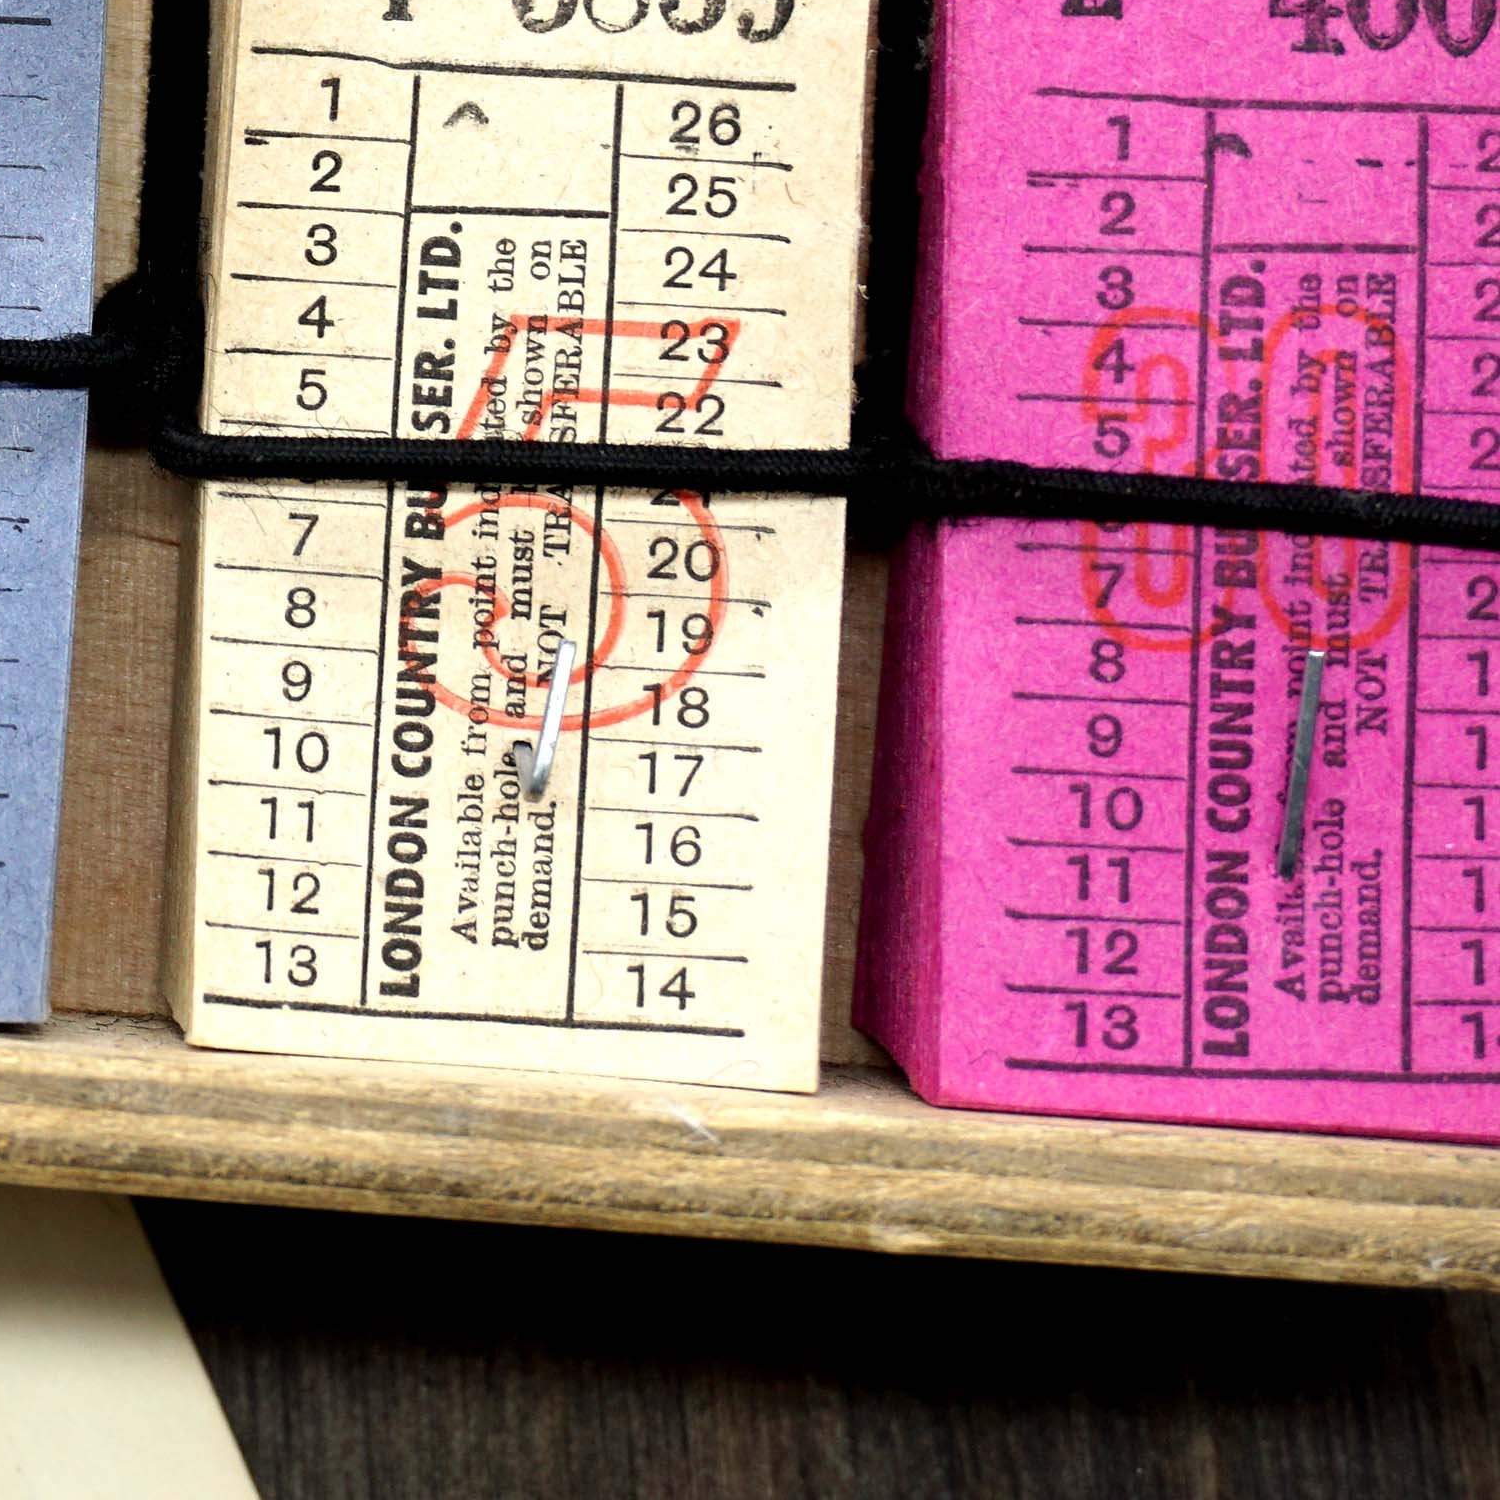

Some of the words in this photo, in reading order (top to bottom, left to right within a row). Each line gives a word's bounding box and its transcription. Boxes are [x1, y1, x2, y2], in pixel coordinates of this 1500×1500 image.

[321, 78, 340, 121] 1
[669, 100, 741, 146] 26
[1107, 115, 1131, 161] 1
[310, 150, 342, 192] 2
[666, 173, 737, 218] 25
[1100, 191, 1136, 236] 2
[417, 222, 462, 320] LTD.
[495, 237, 516, 291] the
[531, 241, 551, 280] on
[663, 247, 737, 291] 24
[1096, 266, 1135, 310] 3
[1218, 260, 1266, 362] LTD.
[1302, 272, 1323, 331] the
[1336, 274, 1359, 318] on
[493, 314, 516, 353] by
[412, 339, 455, 434] SER.
[524, 308, 548, 425] shown
[1216, 379, 1263, 483] SER.
[1325, 350, 1358, 468] shown
[473, 559, 497, 651] point
[509, 530, 534, 620] must
[392, 556, 442, 778] COUNTRY
[506, 653, 528, 718] and
[1358, 651, 1386, 735] NOT
[461, 673, 492, 756] from
[1206, 605, 1256, 833] COUNTRY
[1322, 699, 1347, 768] and
[1069, 783, 1144, 832] 10
[451, 774, 484, 944] Available
[521, 801, 557, 951] demand.
[1067, 854, 1130, 904] 11
[380, 796, 429, 997] LONDON
[631, 893, 697, 938] 15
[1317, 799, 1345, 1003] punch-hole
[1349, 849, 1383, 1006] demand.
[256, 940, 317, 987] 13
[1066, 927, 1138, 975] 12
[1203, 851, 1250, 1057] LONDON
[627, 964, 695, 1010] 14
[1065, 1001, 1139, 1051] 13
